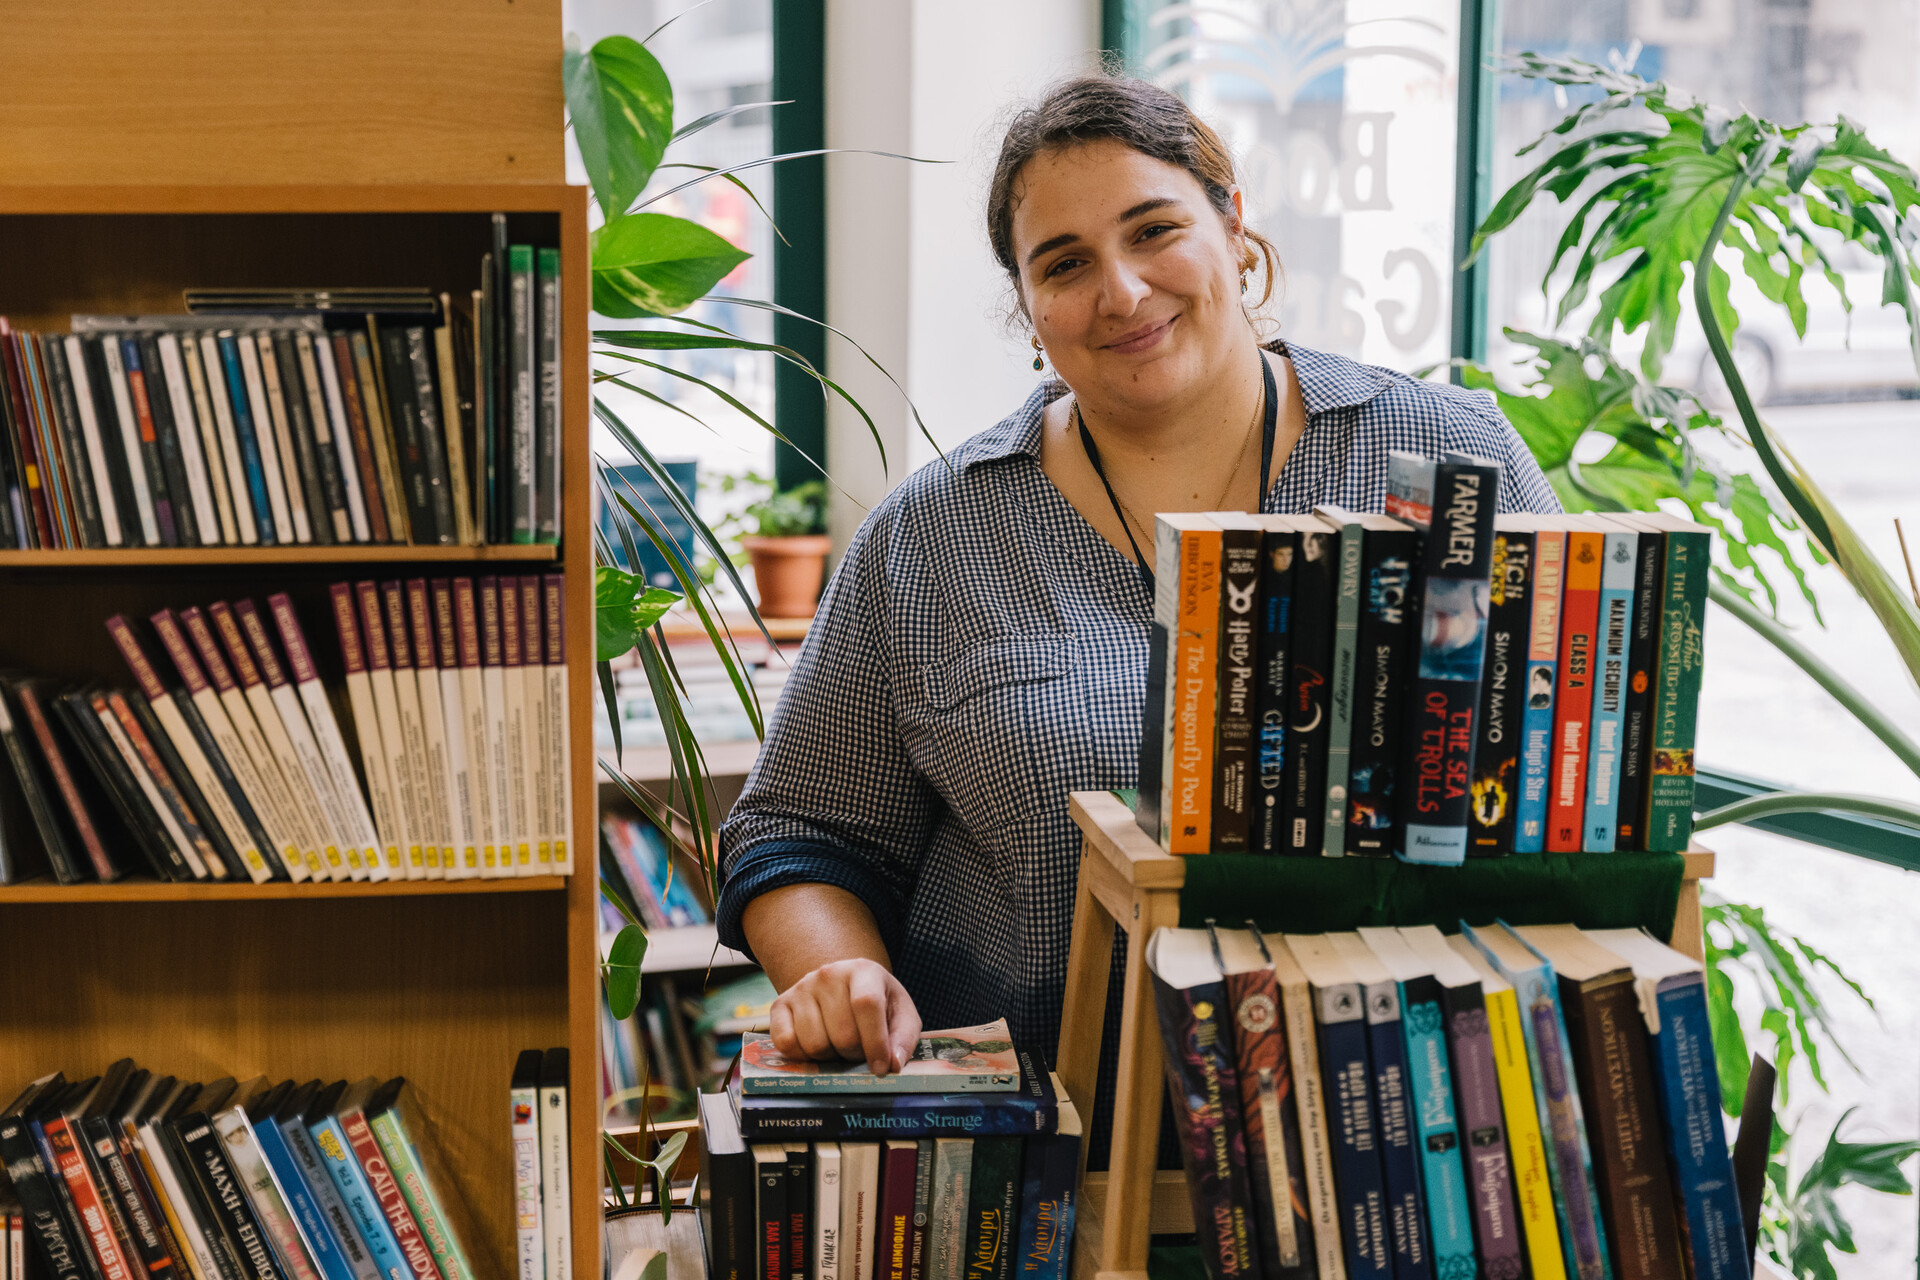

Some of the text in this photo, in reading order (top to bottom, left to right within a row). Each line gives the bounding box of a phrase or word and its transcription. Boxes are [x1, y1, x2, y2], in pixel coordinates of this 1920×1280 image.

[1441, 472, 1480, 570] FARMER
[1185, 536, 1200, 617] IBBOTSON
[1200, 560, 1214, 594] EVA
[1342, 539, 1359, 600] LOWRY
[1537, 540, 1559, 598] HILARY
[1638, 546, 1656, 640] VAMPIRE MOUNTAIN
[1673, 544, 1687, 604] AT THE
[1569, 633, 1588, 689] CLASS A
[1602, 599, 1626, 713] MAXIMUM SECURITY
[1681, 600, 1702, 673] Arthur
[1228, 622, 1253, 715] Harry Potter
[1371, 645, 1390, 747] SIMON MAYO
[1488, 631, 1510, 744] SIMON MAYO
[1180, 646, 1204, 816] The Dragonfly Pool
[1260, 708, 1284, 790] GIFTED
[1417, 692, 1448, 814] OF TROLLS
[1445, 708, 1472, 800] THE SEA
[1627, 711, 1643, 778] DARREN SHAN
[1235, 773, 1244, 814] ROWLING
[1524, 729, 1548, 803] Indigo's Star
[1559, 720, 1582, 807] Robert Muchamore
[1595, 720, 1618, 806] Robert Muchamore
[1653, 788, 1693, 798] CROSSLEY-
[1662, 777, 1686, 788] KEVIN
[1654, 798, 1692, 808] HOLLAND
[754, 1078, 780, 1088] Susan
[782, 1078, 807, 1089] Cooper
[812, 1077, 830, 1087] Over
[1021, 1051, 1044, 1097] LESLEY LIVINGSTON
[1601, 1006, 1624, 1100] ΜΥΣΤΙΚΩΝ
[1673, 1015, 1697, 1100] ΜΥΣΤΙΚΩΝ
[758, 1111, 983, 1132] LIVINGSTON Wondrous Strange
[1213, 1124, 1231, 1180] ΤΟΜΑΣ
[1617, 1113, 1635, 1162] ΣΠΙΤΙ
[1686, 1115, 1704, 1158] ΣΠΙΤΙ
[108, 1155, 132, 1191] HERBERT
[125, 1191, 140, 1211] VON
[134, 1207, 158, 1248] KARAJAN
[205, 1156, 240, 1211] ΜΑΧΗ
[290, 1128, 317, 1170] MARCH
[329, 1205, 363, 1263] PENGUINS
[365, 1157, 415, 1237] CALL THE
[403, 1171, 447, 1255] Elmo's Potty
[857, 1190, 865, 1223] πρίγκιπες
[83, 1205, 103, 1233] 3000
[93, 1232, 117, 1266] MILES
[108, 1264, 123, 1280] TO
[351, 1195, 374, 1237] Episodes
[369, 1231, 380, 1241] 7
[766, 1221, 780, 1243] ΣΑΛΑ
[791, 1213, 804, 1269] ΣΑΛΑ ΣΙΜΟΥΚΑ
[856, 1224, 865, 1252] μικρούς
[891, 1214, 906, 1268] ΔΗΜΟΦΙΛΗΣ
[912, 1231, 923, 1265] ΑΝΤΩΝΗΣ
[972, 1209, 998, 1272] Λάουρα
[1025, 1200, 1055, 1272] Η Λάουρα
[1213, 1205, 1240, 1276] ΔΡΑΚΟΥ
[1353, 1203, 1369, 1260] ΑΝΤΟΝΙ
[1393, 1204, 1407, 1255] ΑΝΤΟΝΙ
